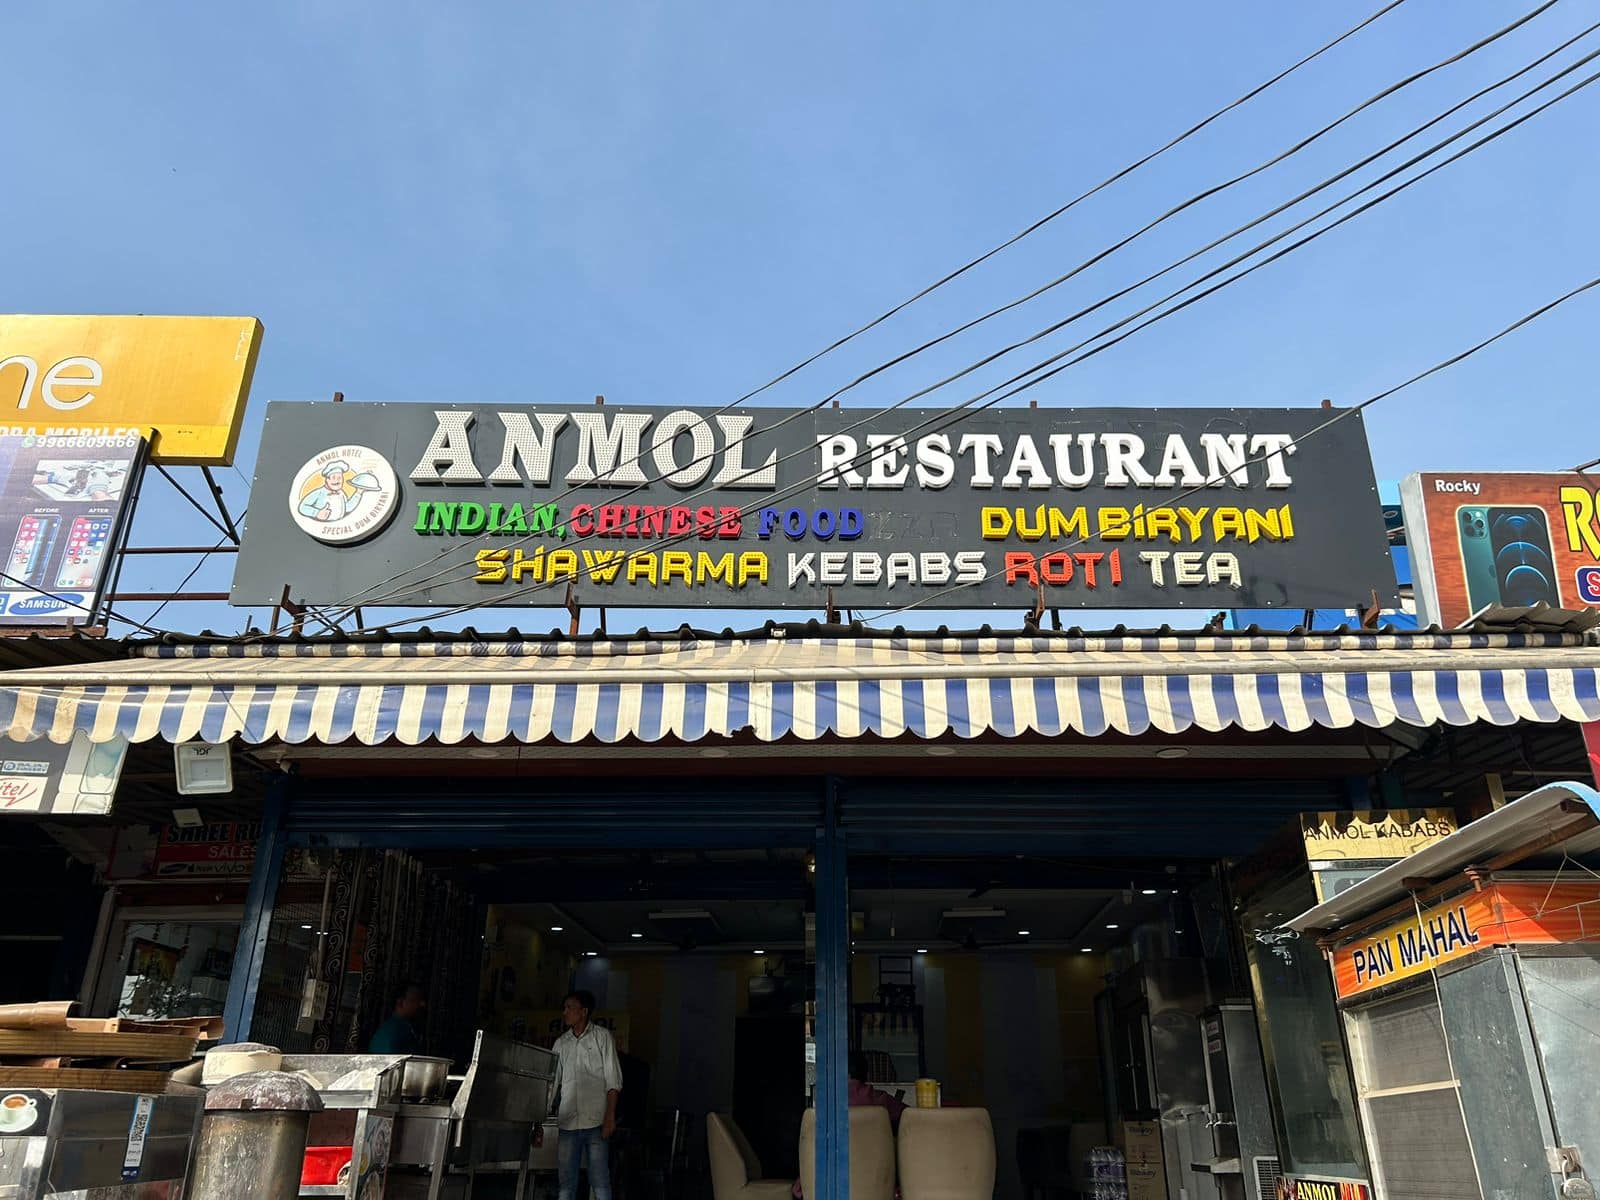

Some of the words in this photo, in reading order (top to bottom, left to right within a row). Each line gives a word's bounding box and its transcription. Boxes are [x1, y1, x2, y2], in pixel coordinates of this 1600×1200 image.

[316, 449, 340, 466] ANMOL
[409, 410, 776, 488] ANMOL
[816, 433, 1296, 489] RESTAURANT
[1434, 479, 1481, 495] Rocky
[321, 525, 353, 535] SPECIAL
[571, 503, 742, 539] CHINESE
[758, 505, 864, 541] FOOD
[981, 504, 1089, 541] DUM
[1098, 503, 1294, 543] BIRYANI
[1560, 485, 1600, 561] R
[473, 545, 769, 588] SHAWARMA
[787, 551, 987, 588] KEBABS
[1004, 548, 1121, 587] ROTI
[1139, 551, 1243, 588] TEA
[1304, 824, 1370, 841] ANMOL
[1374, 821, 1452, 839] KABABS
[1353, 938, 1394, 985] PAN
[1396, 905, 1480, 968] MAHAL
